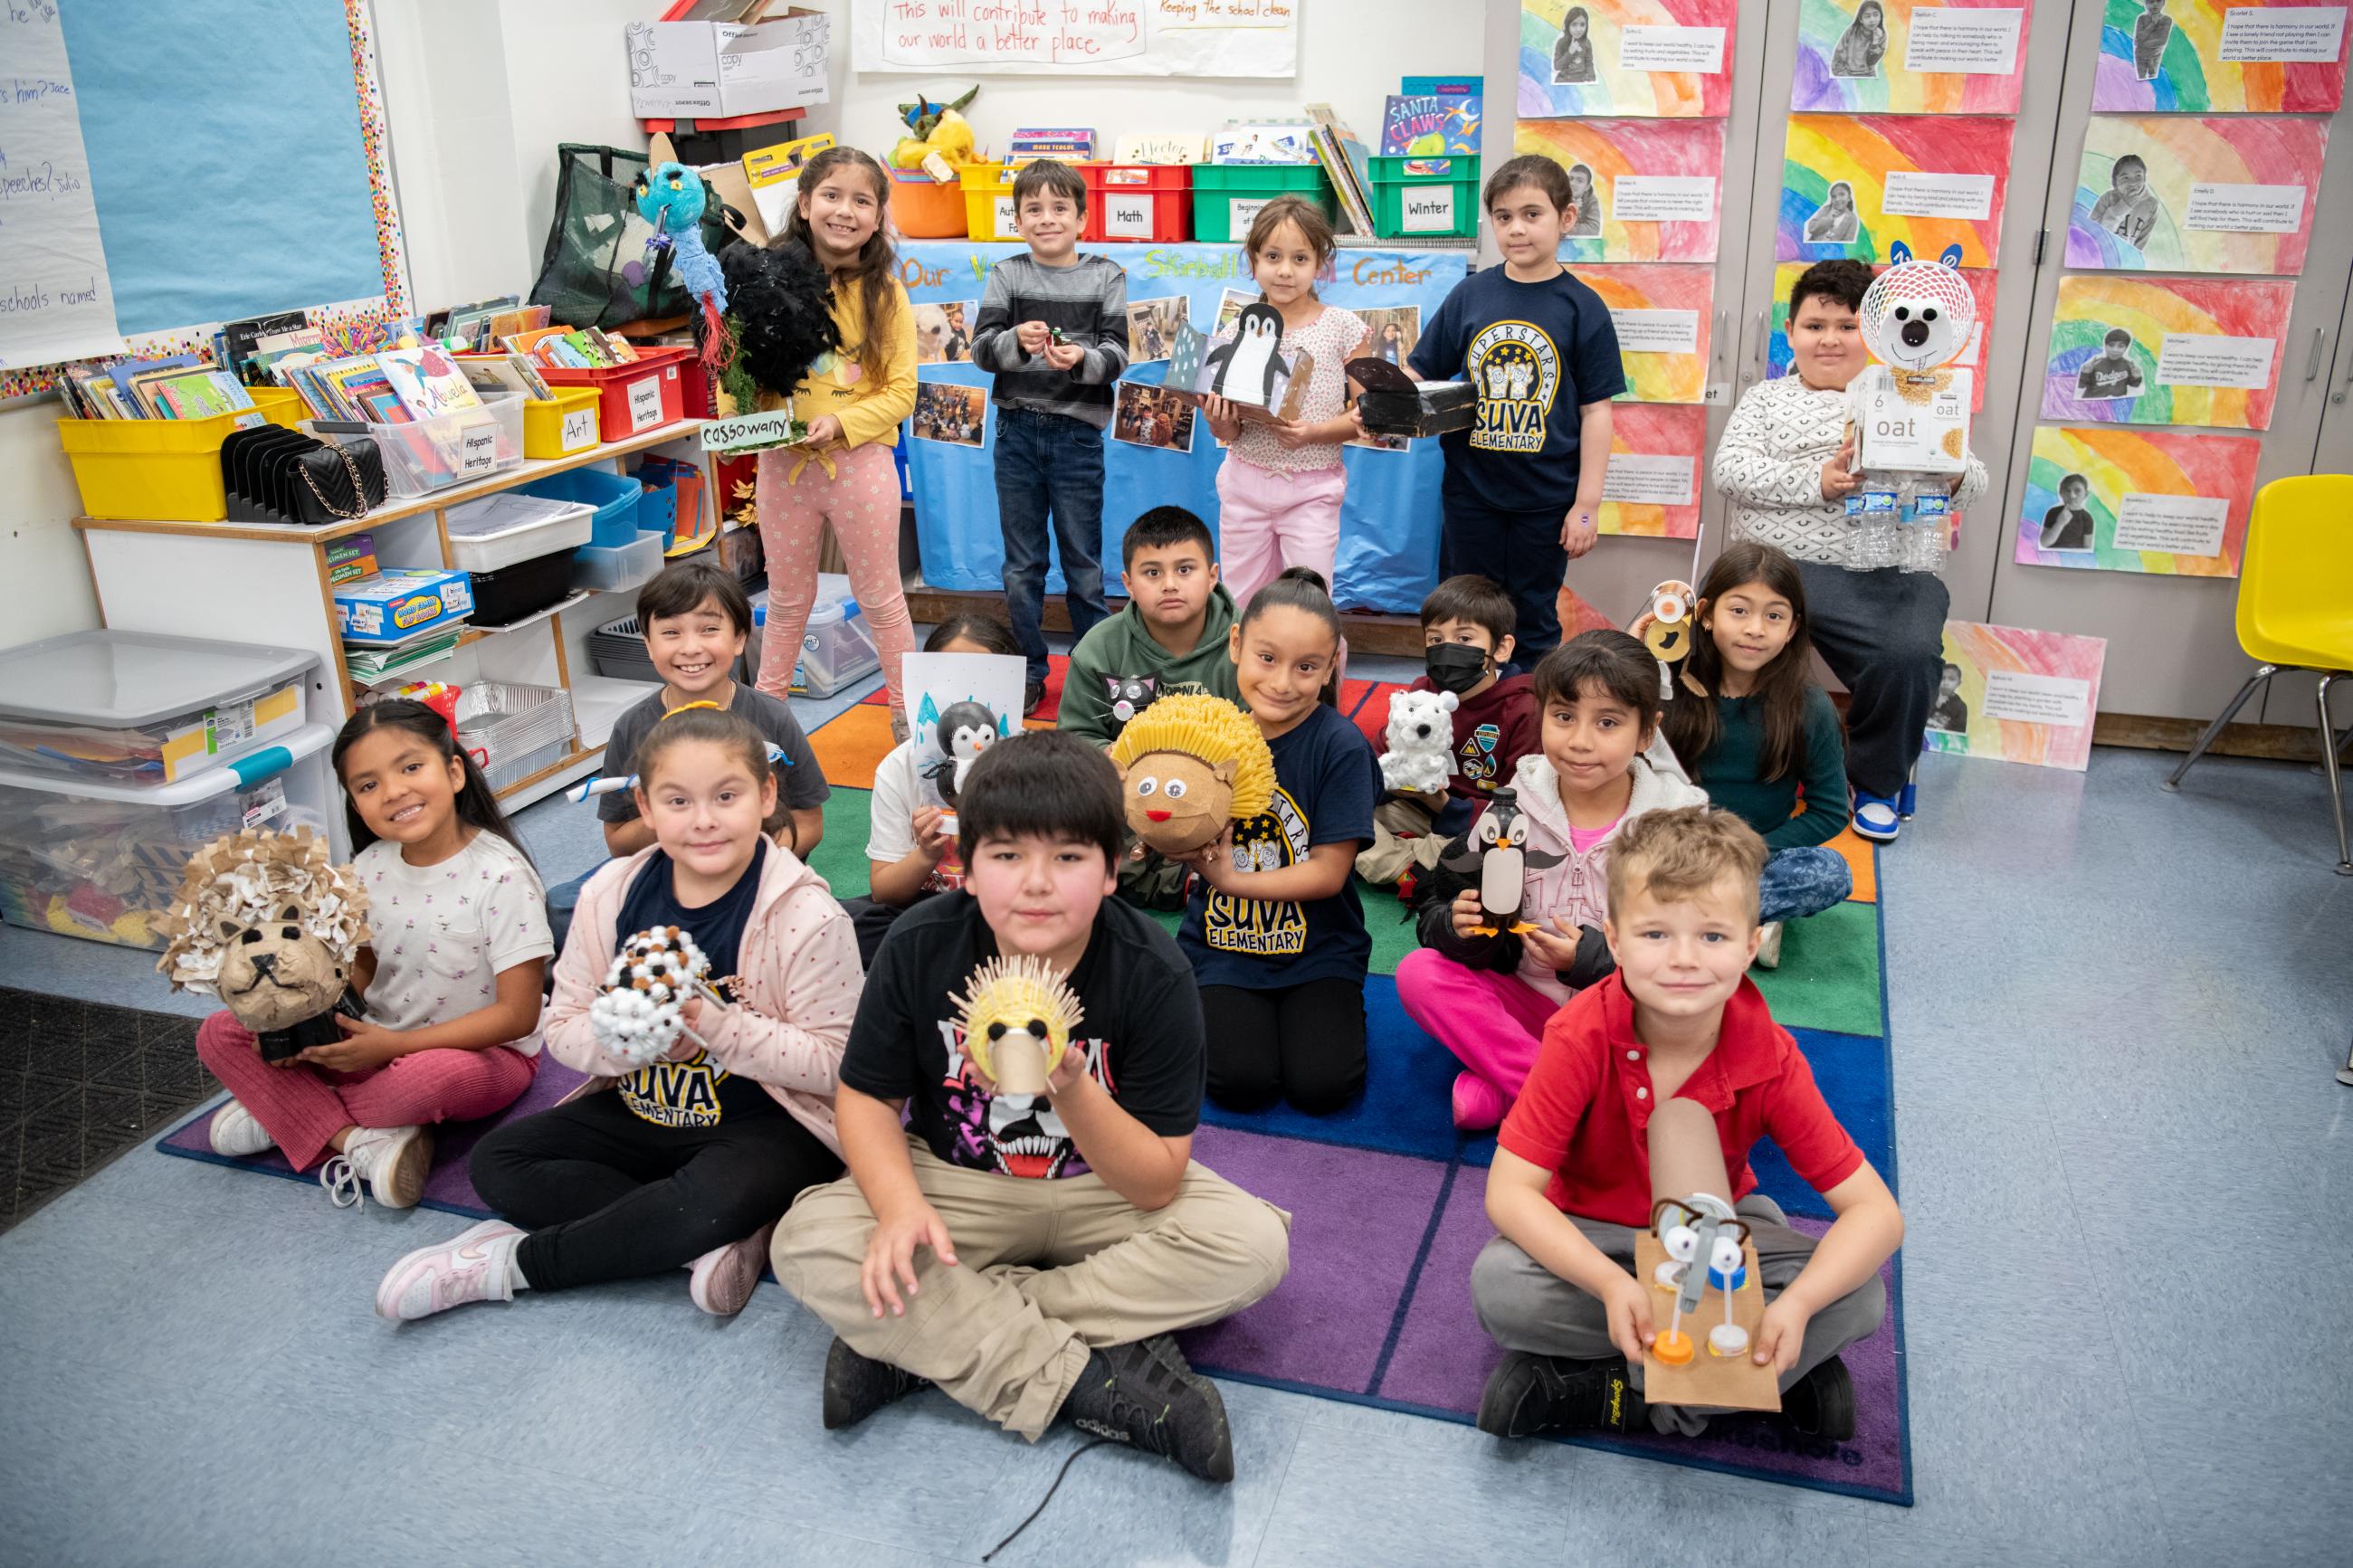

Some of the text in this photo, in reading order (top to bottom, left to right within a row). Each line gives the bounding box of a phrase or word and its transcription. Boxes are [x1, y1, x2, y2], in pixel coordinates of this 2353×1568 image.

[7, 0, 29, 23] he
[1227, 0, 1261, 16] school
[1262, 0, 1291, 18] clean
[894, 0, 1138, 43] This will contribute to making
[899, 33, 921, 48] our
[929, 24, 967, 50] world
[976, 36, 986, 51] a
[995, 24, 1039, 51] better
[721, 55, 742, 67] copy
[14, 79, 46, 108] him?
[1389, 96, 1439, 123] SANTA
[1389, 113, 1445, 142] CLAWS
[53, 172, 81, 193] Julio
[1117, 210, 1143, 223] Math
[1408, 201, 1449, 215] Winter
[1243, 216, 1252, 225] of
[902, 257, 950, 290] Our
[1144, 249, 1238, 280] Skirball
[1353, 257, 1433, 286] Center
[0, 276, 97, 312] schools named
[240, 332, 251, 341] Eric
[292, 323, 302, 331] Star
[1471, 326, 1555, 379] SUPERSTARS
[432, 377, 469, 410] Abuela
[634, 389, 655, 405] Hispanic
[1874, 394, 1883, 408] 6
[636, 407, 658, 423] Heritage
[1475, 401, 1542, 433] SUVA
[1936, 404, 1959, 416] oat
[566, 413, 588, 442] Art
[1876, 417, 1916, 438] oat
[465, 434, 493, 451] Hispanic
[1471, 431, 1542, 451] ELEMENTARY
[464, 454, 492, 470] Heritage
[397, 605, 416, 619] WORD
[416, 597, 437, 610] FAMILY
[1208, 889, 1303, 933] SUVA
[1209, 927, 1304, 952] ELEMENTARY
[1075, 1418, 1130, 1441] adidas
